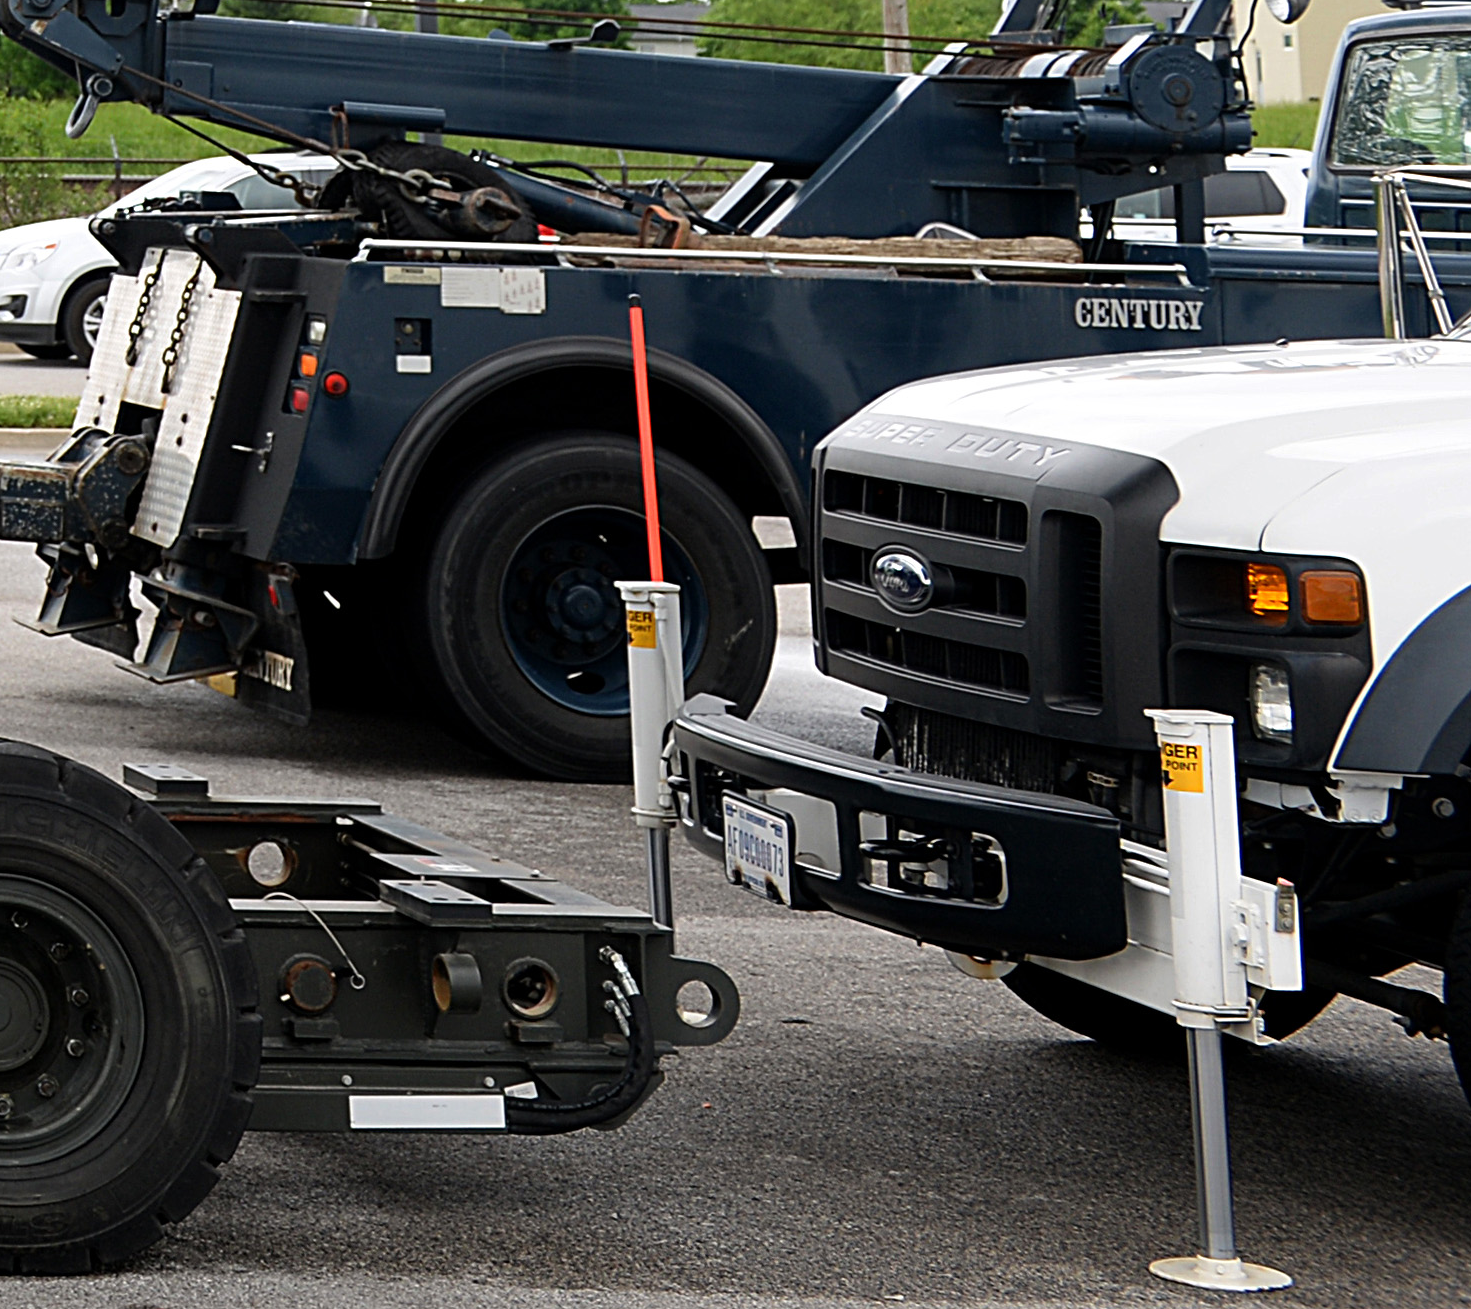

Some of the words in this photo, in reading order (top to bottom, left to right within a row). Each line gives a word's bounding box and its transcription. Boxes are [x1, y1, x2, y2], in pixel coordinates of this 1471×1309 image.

[1075, 298, 1204, 330] CENTURY
[846, 420, 942, 450] SUPER
[946, 434, 1072, 468] DUTY
[1165, 759, 1198, 772] POINT
